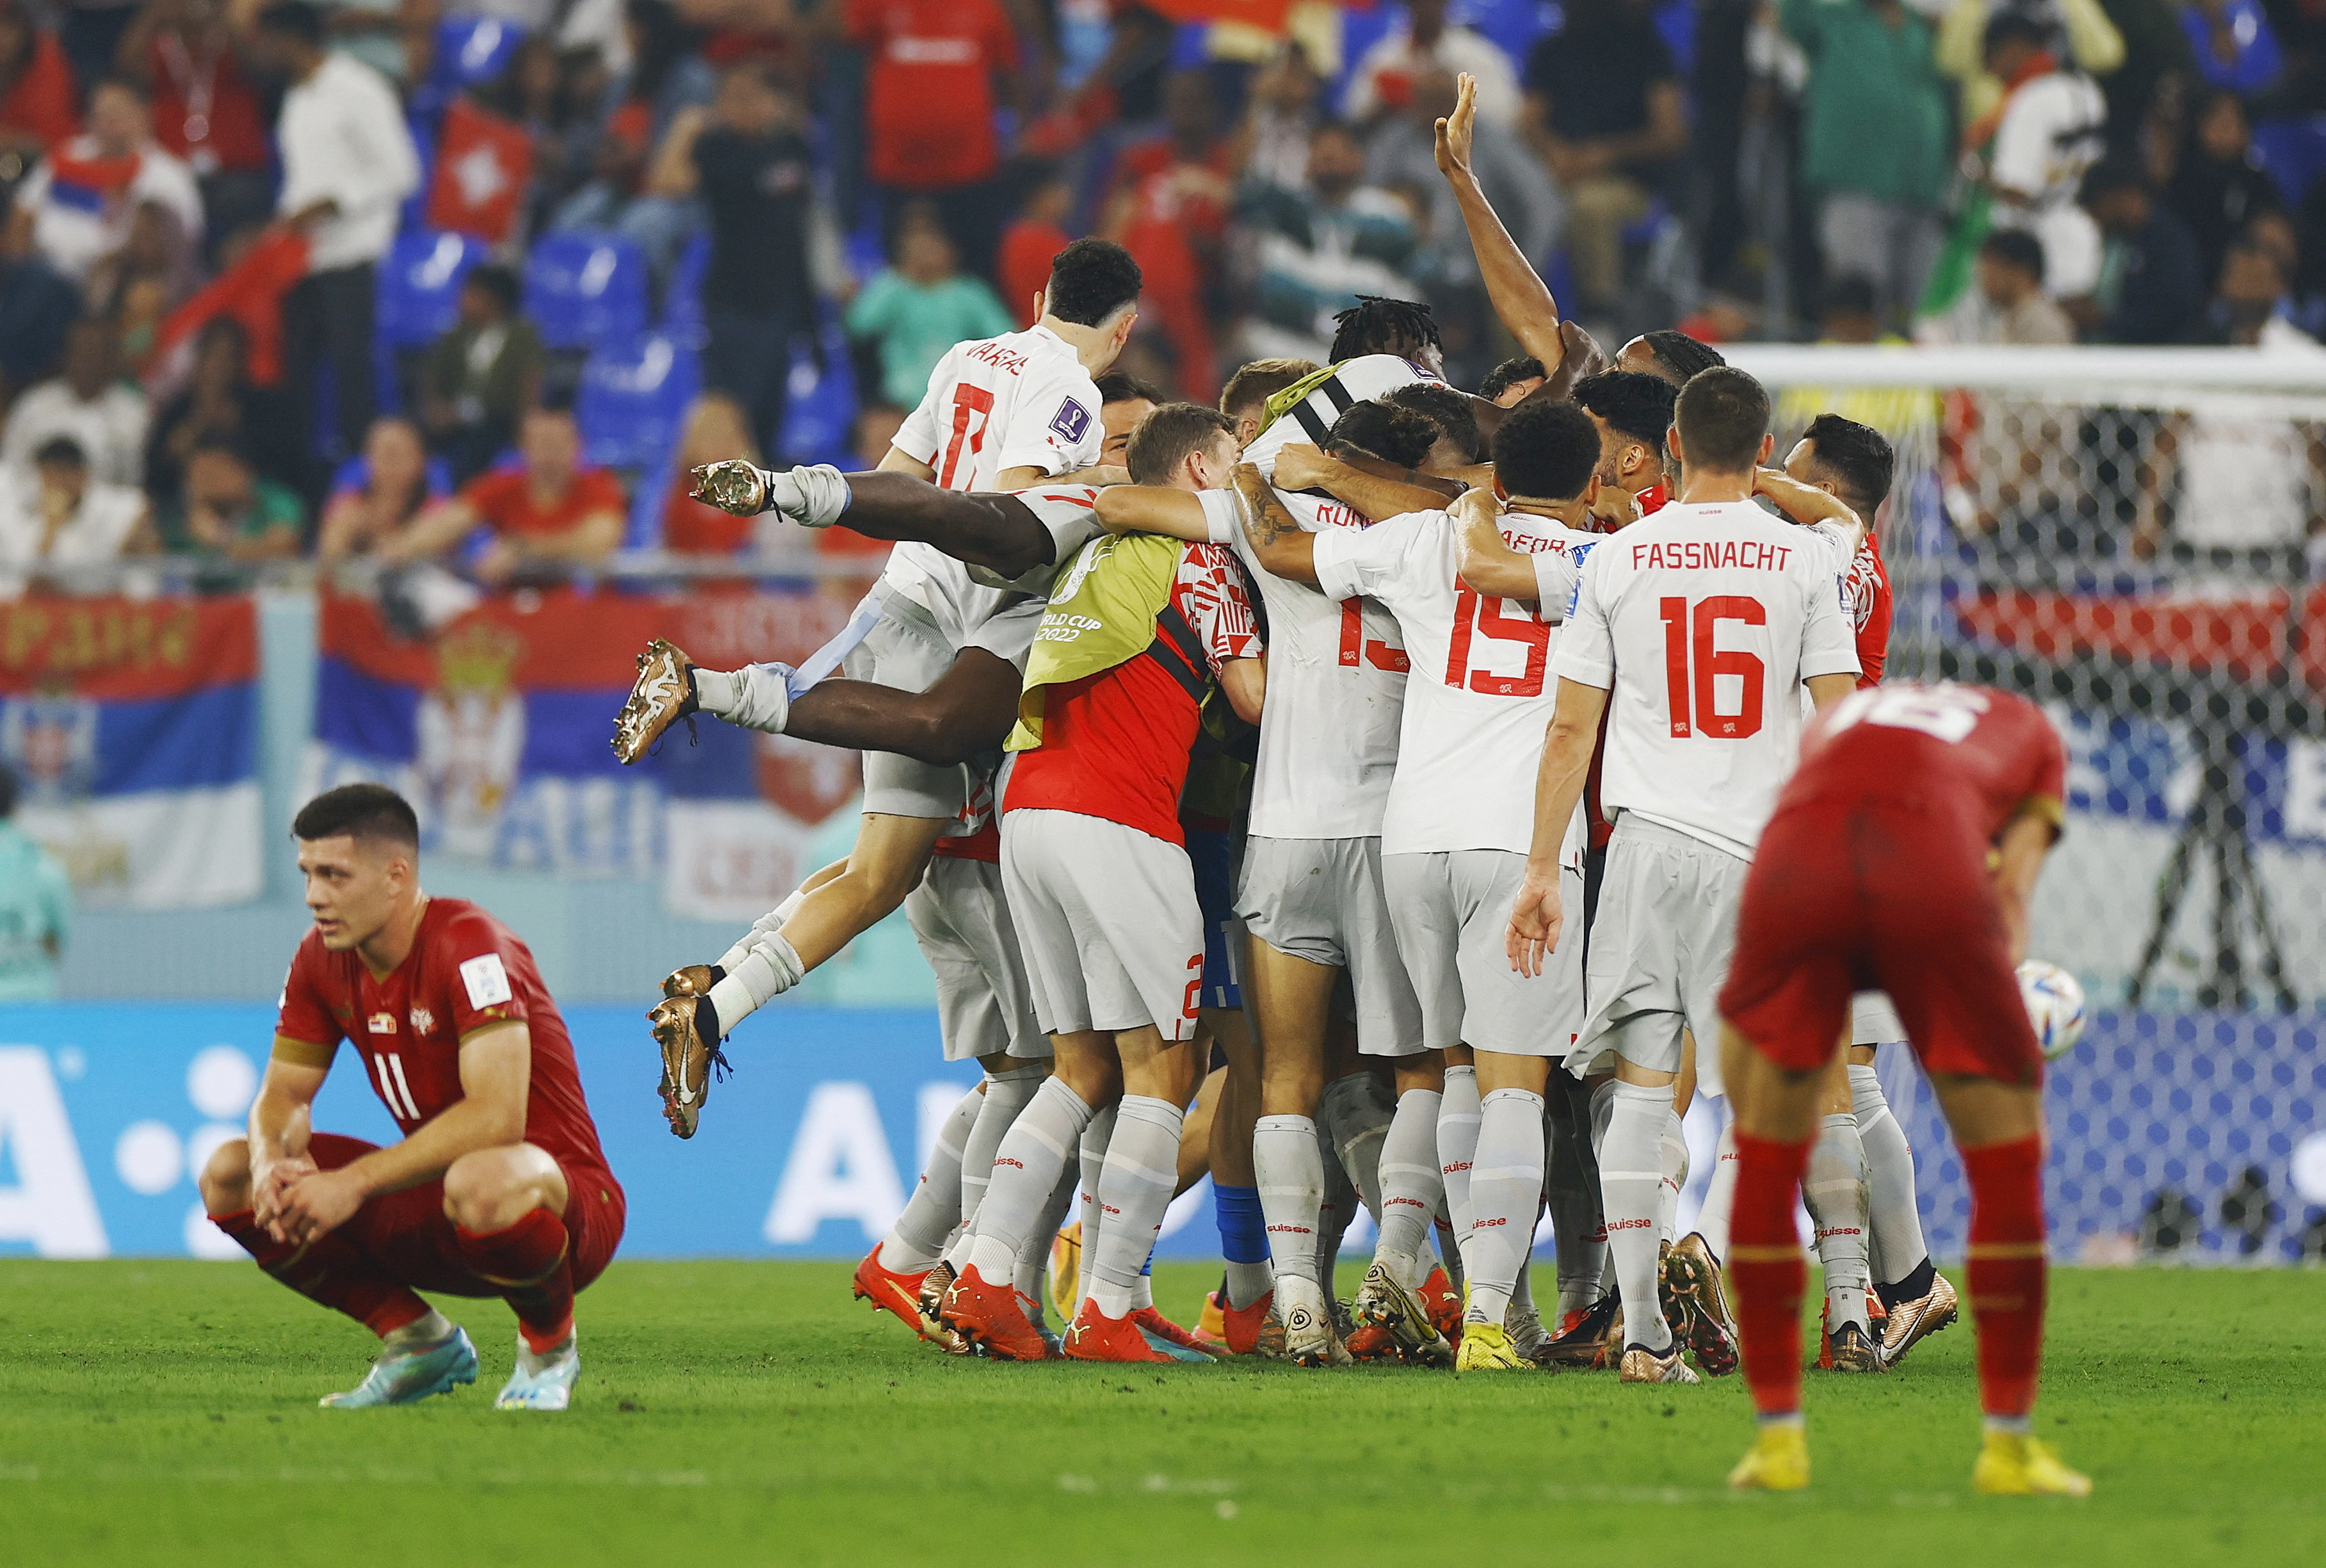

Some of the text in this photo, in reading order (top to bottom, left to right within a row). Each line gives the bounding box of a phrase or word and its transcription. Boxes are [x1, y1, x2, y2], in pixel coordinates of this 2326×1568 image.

[966, 342, 1029, 376] VARGAS
[1501, 530, 1567, 559] AFOR
[1632, 541, 1792, 572] FASSNACHT
[1040, 613, 1102, 631] RLD CUP
[1034, 627, 1081, 643] 2022
[1660, 595, 1766, 739] 16
[374, 1052, 422, 1120] 11
[993, 1156, 1024, 1170] uisse
[1443, 1161, 1473, 1175] suis
[1383, 1196, 1425, 1209] suisse
[1267, 1224, 1312, 1234] suisse
[1472, 1216, 1507, 1230] uisse
[1607, 1218, 1652, 1231] suisse
[1820, 1226, 1861, 1238] suisse
